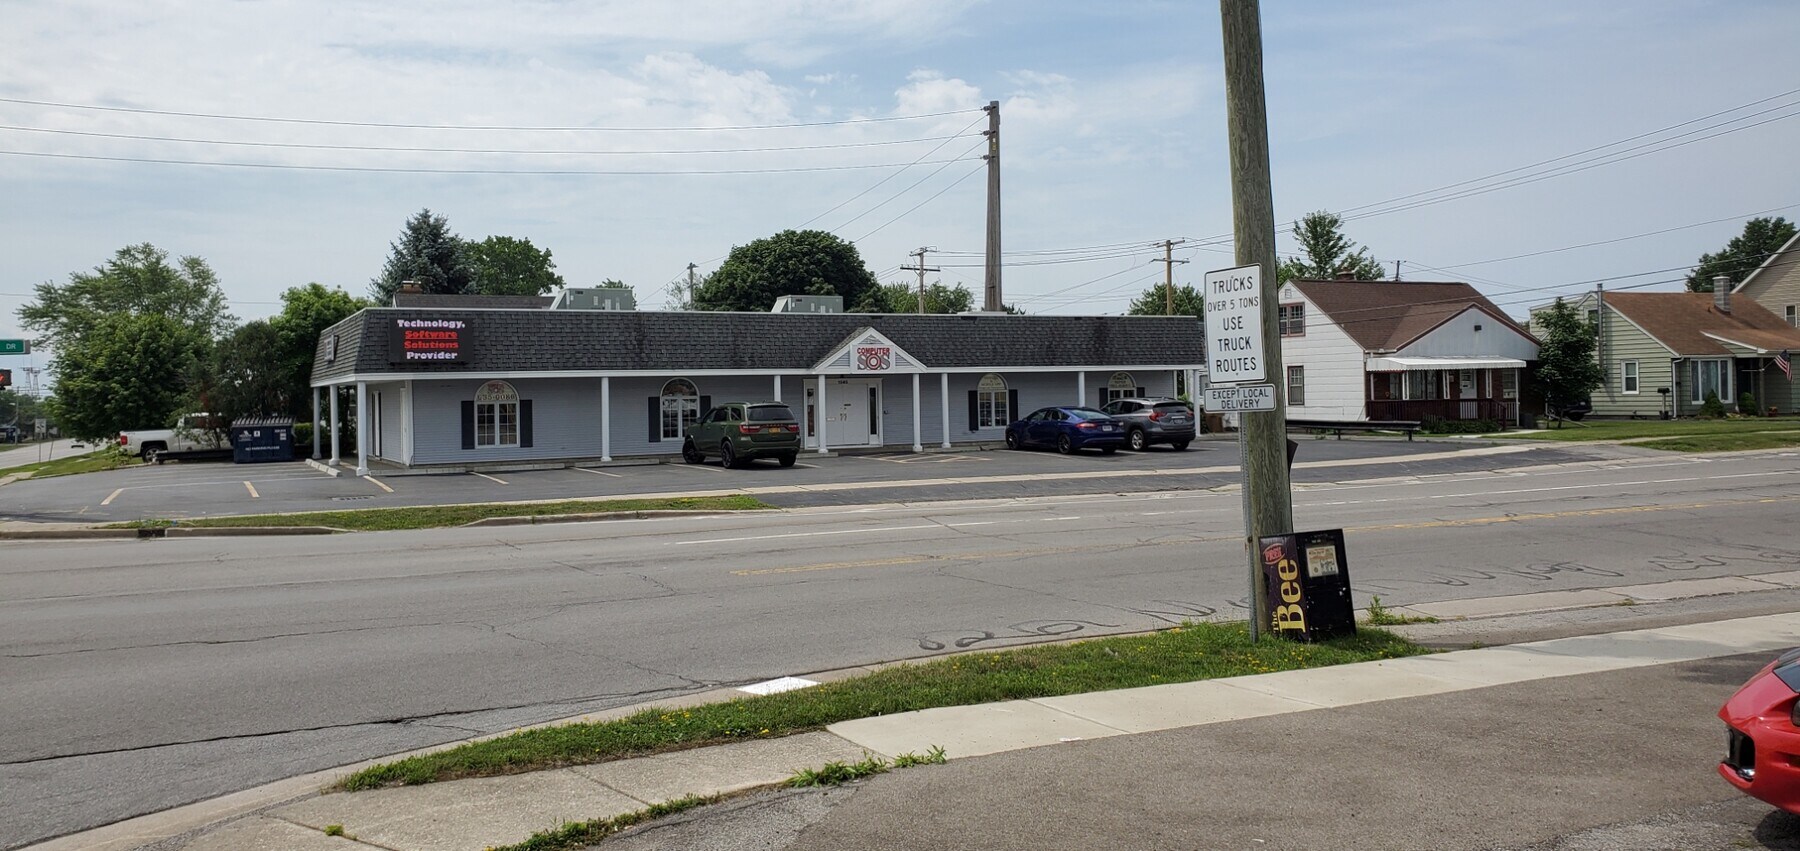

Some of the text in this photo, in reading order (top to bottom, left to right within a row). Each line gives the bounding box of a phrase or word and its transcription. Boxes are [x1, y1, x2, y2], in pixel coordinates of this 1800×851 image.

[1212, 276, 1253, 294] TRUCKS
[1207, 296, 1259, 312] OVER 5 TONS
[1222, 316, 1244, 331] USE
[405, 330, 458, 339] Software
[404, 341, 459, 349] Solutions
[857, 347, 890, 355] COMPUTER
[1217, 336, 1252, 352] TRUCK
[406, 351, 458, 359] Provider
[857, 353, 890, 370] SOS
[1216, 357, 1257, 373] ROUTES
[1212, 387, 1269, 399] EXCEPT LOCAL
[1221, 399, 1260, 409] DELIVERY
[1277, 559, 1306, 633] Bee
